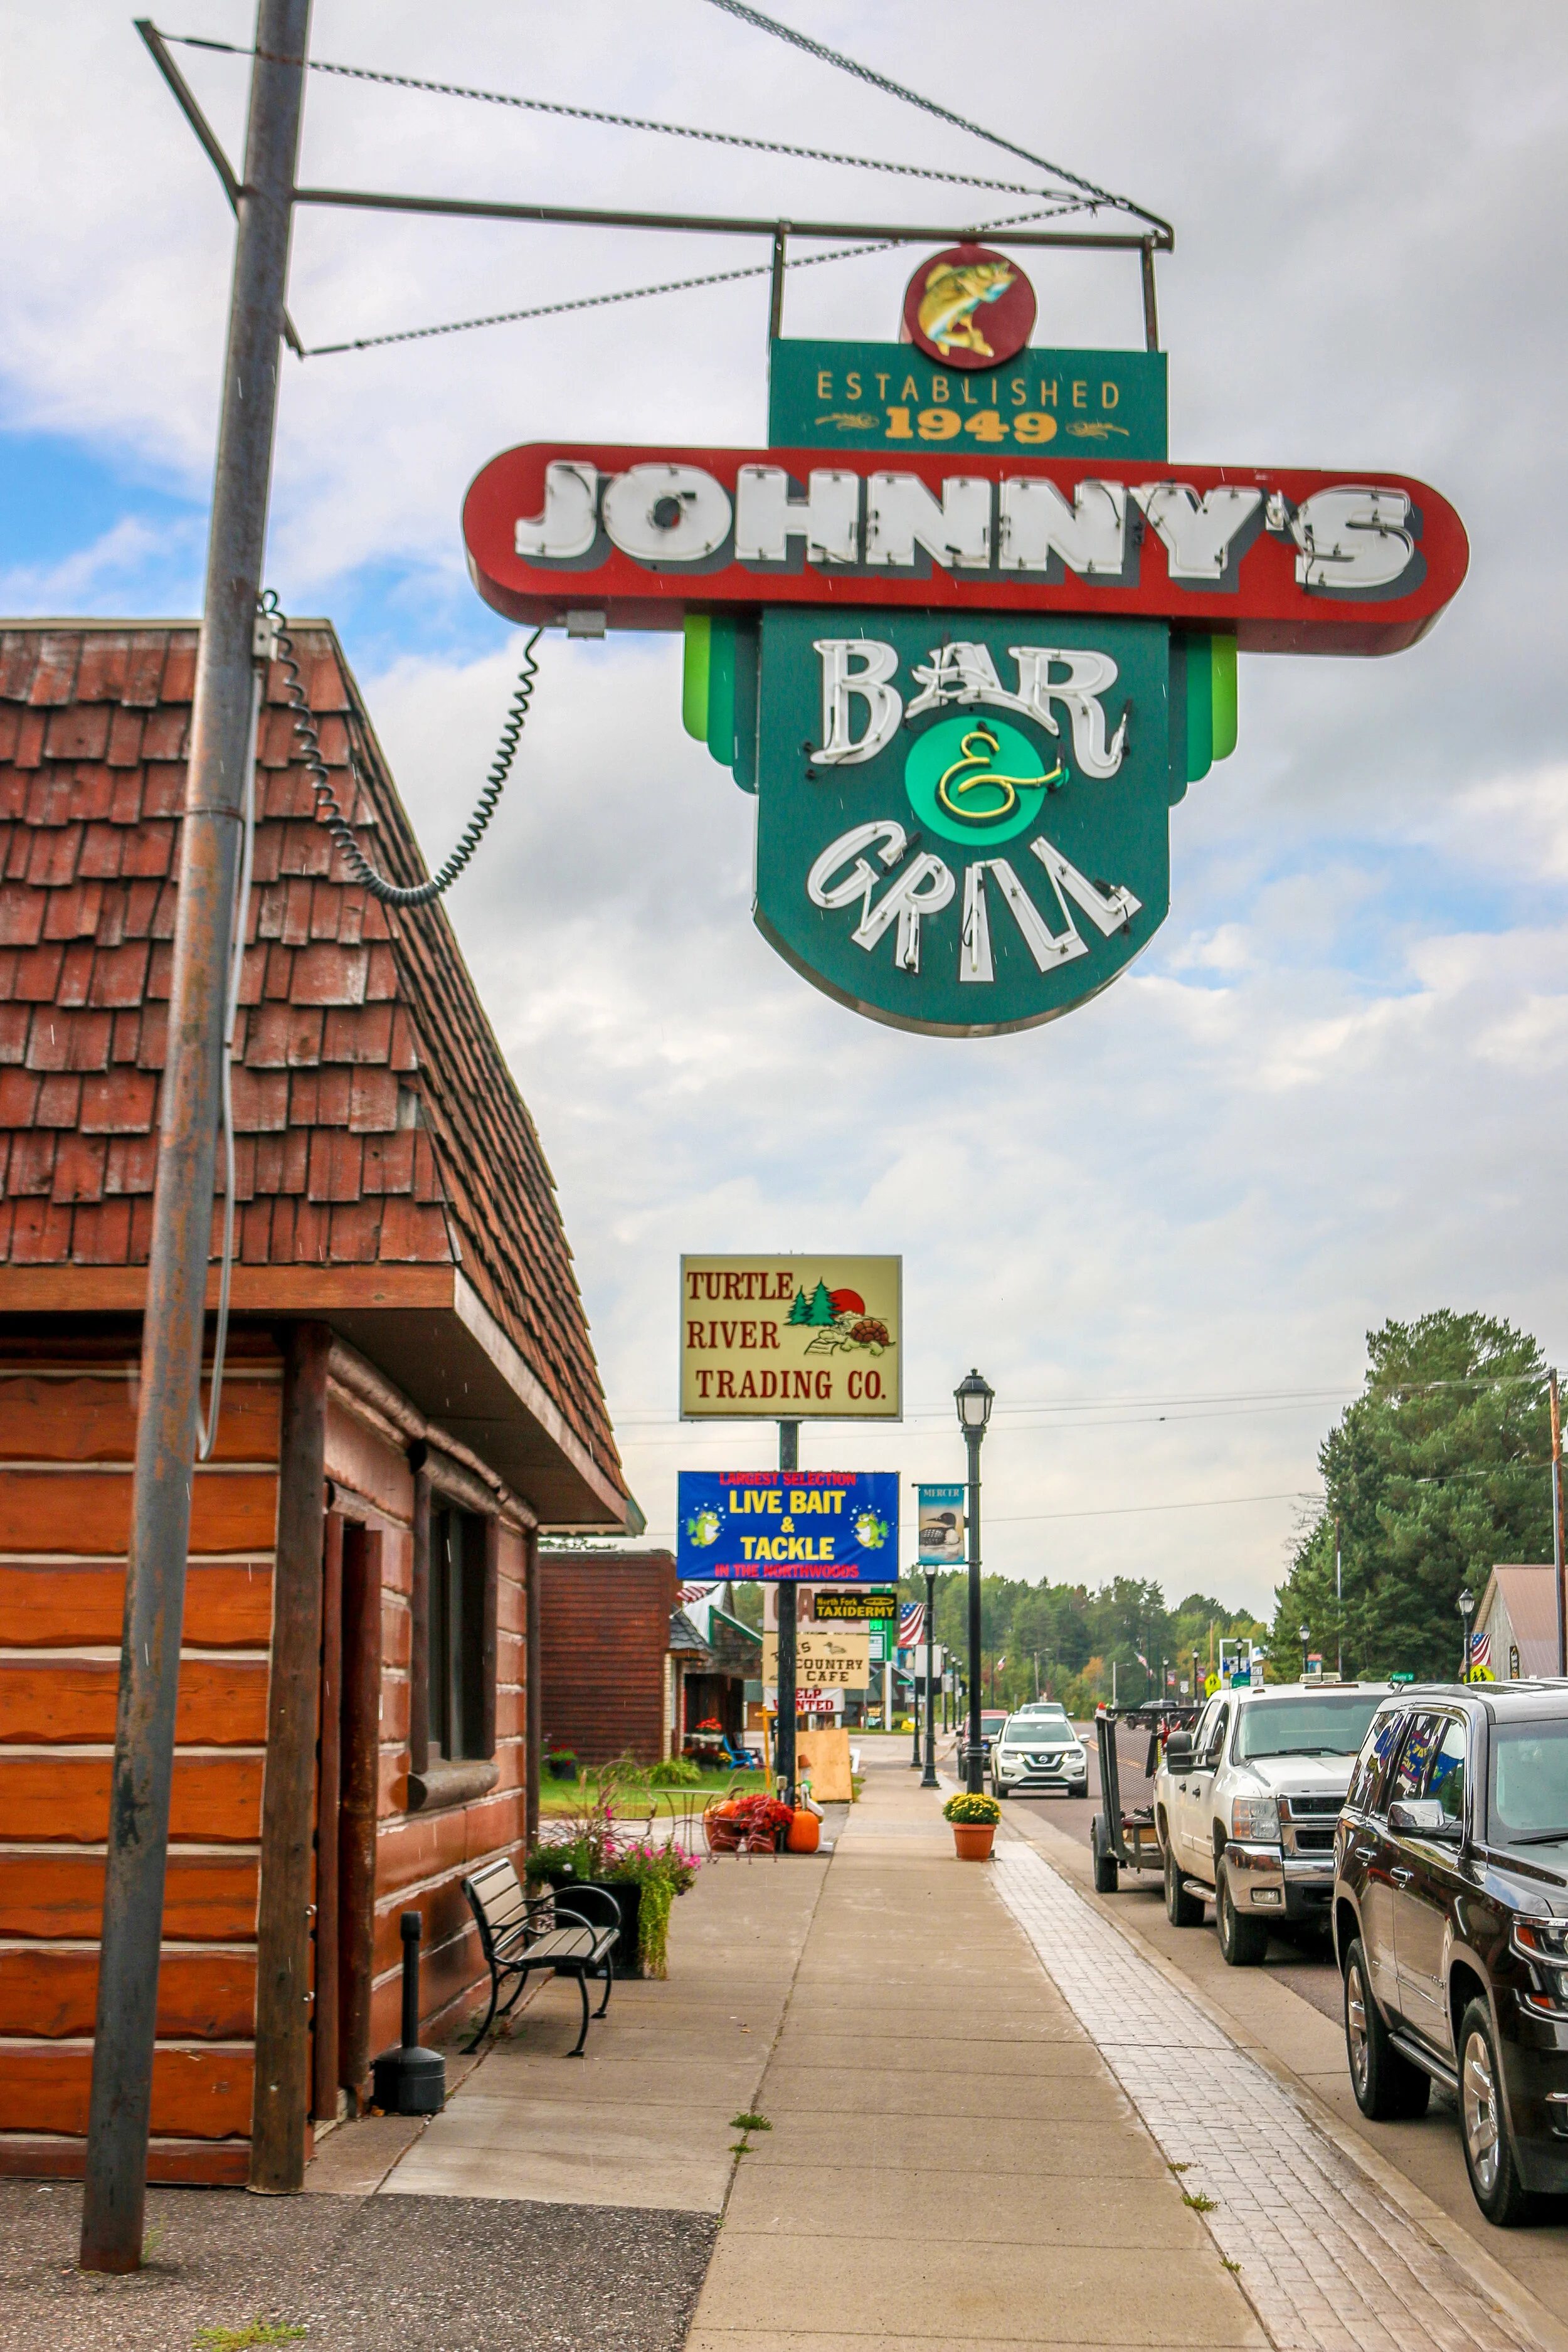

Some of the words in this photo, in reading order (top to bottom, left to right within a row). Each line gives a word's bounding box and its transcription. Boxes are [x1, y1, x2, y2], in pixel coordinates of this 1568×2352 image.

[817, 371, 1120, 409] ESTABLISHED
[885, 406, 1058, 444] 1949
[514, 460, 1419, 589] JOHNNY'S
[810, 638, 1125, 779] BAR
[940, 731, 1062, 818] &
[807, 820, 1142, 982] GRILL
[687, 1272, 793, 1300] TURTLE
[687, 1321, 780, 1349] RIVER
[696, 1370, 833, 1399] TRADING
[847, 1370, 887, 1400] CO.
[719, 1472, 778, 1486] LARGEST
[783, 1472, 856, 1486] SELECTION
[729, 1490, 783, 1514] LIVE
[790, 1490, 846, 1514] BAIT
[923, 1488, 960, 1497] MERCER
[780, 1516, 795, 1534] &
[740, 1537, 835, 1560] TACKLE
[715, 1564, 727, 1577] IN
[731, 1564, 760, 1577] THE
[763, 1564, 859, 1578] NORTHWOODS
[817, 1597, 839, 1606] North
[840, 1597, 857, 1606] Fork
[817, 1606, 894, 1616] TAXIDERMY
[807, 1671, 849, 1682] CAFE
[795, 1688, 822, 1699] ELP
[773, 1700, 834, 1711] NTED
